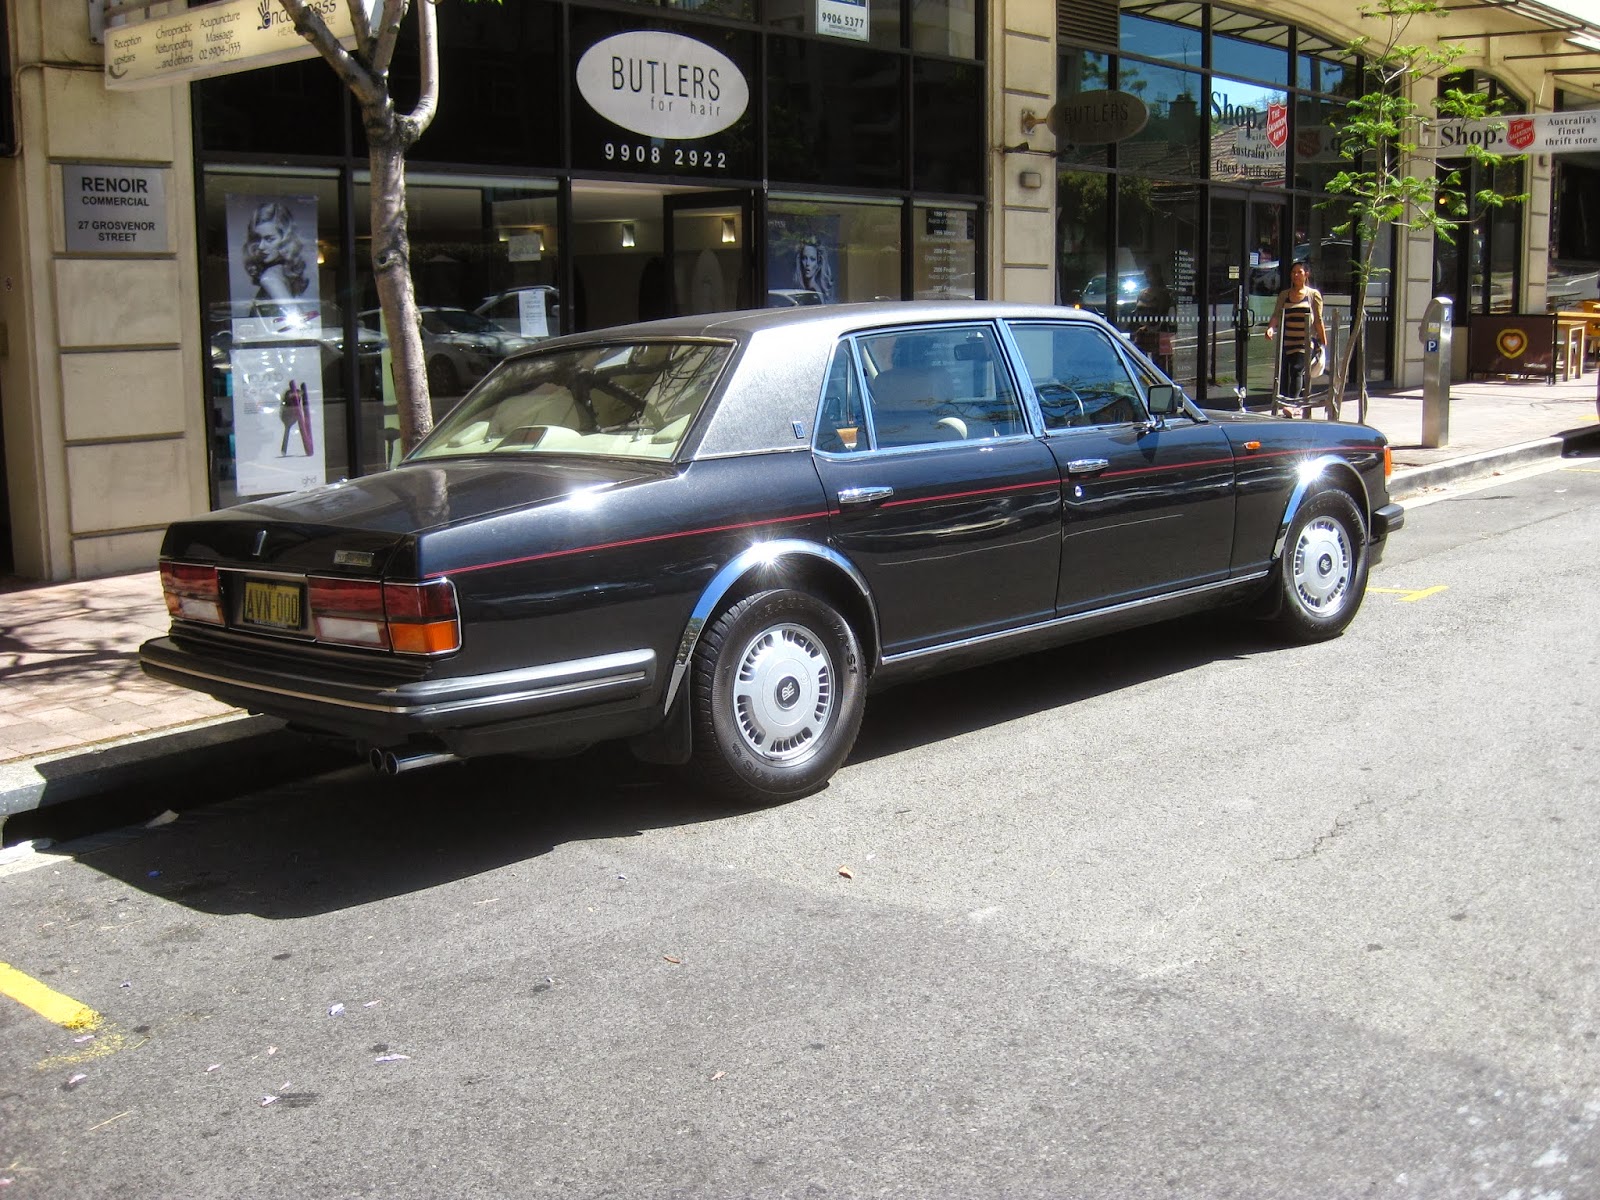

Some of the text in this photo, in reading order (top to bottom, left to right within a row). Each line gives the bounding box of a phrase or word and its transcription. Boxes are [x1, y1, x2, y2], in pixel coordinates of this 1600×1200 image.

[200, 12, 240, 32] Acupuncture
[821, 12, 842, 24] 9906
[845, 16, 864, 28] 5377
[155, 22, 193, 41] Chiropractic
[206, 30, 234, 44] Massage
[277, 26, 295, 37] HEAL
[114, 36, 142, 52] Reception
[155, 35, 194, 54] Naturopathy
[114, 54, 136, 70] upstairs
[173, 53, 194, 66] others
[199, 50, 208, 60] 02
[611, 56, 720, 101] BUTLERS
[651, 97, 721, 116] for hair
[1064, 103, 1128, 124] BUTLERS
[1547, 115, 1597, 126] Australia's
[1440, 126, 1503, 149] Shop.
[1558, 127, 1585, 136] finest
[1515, 134, 1531, 145] ARMY
[1545, 136, 1598, 146] thrift store
[604, 143, 726, 168] 9908 2922
[81, 177, 149, 194] RENOIR
[82, 196, 150, 206] COMMERCIAL
[78, 221, 155, 231] 27 GROSVENOR
[98, 233, 137, 242] STREET
[1428, 341, 1437, 352] P
